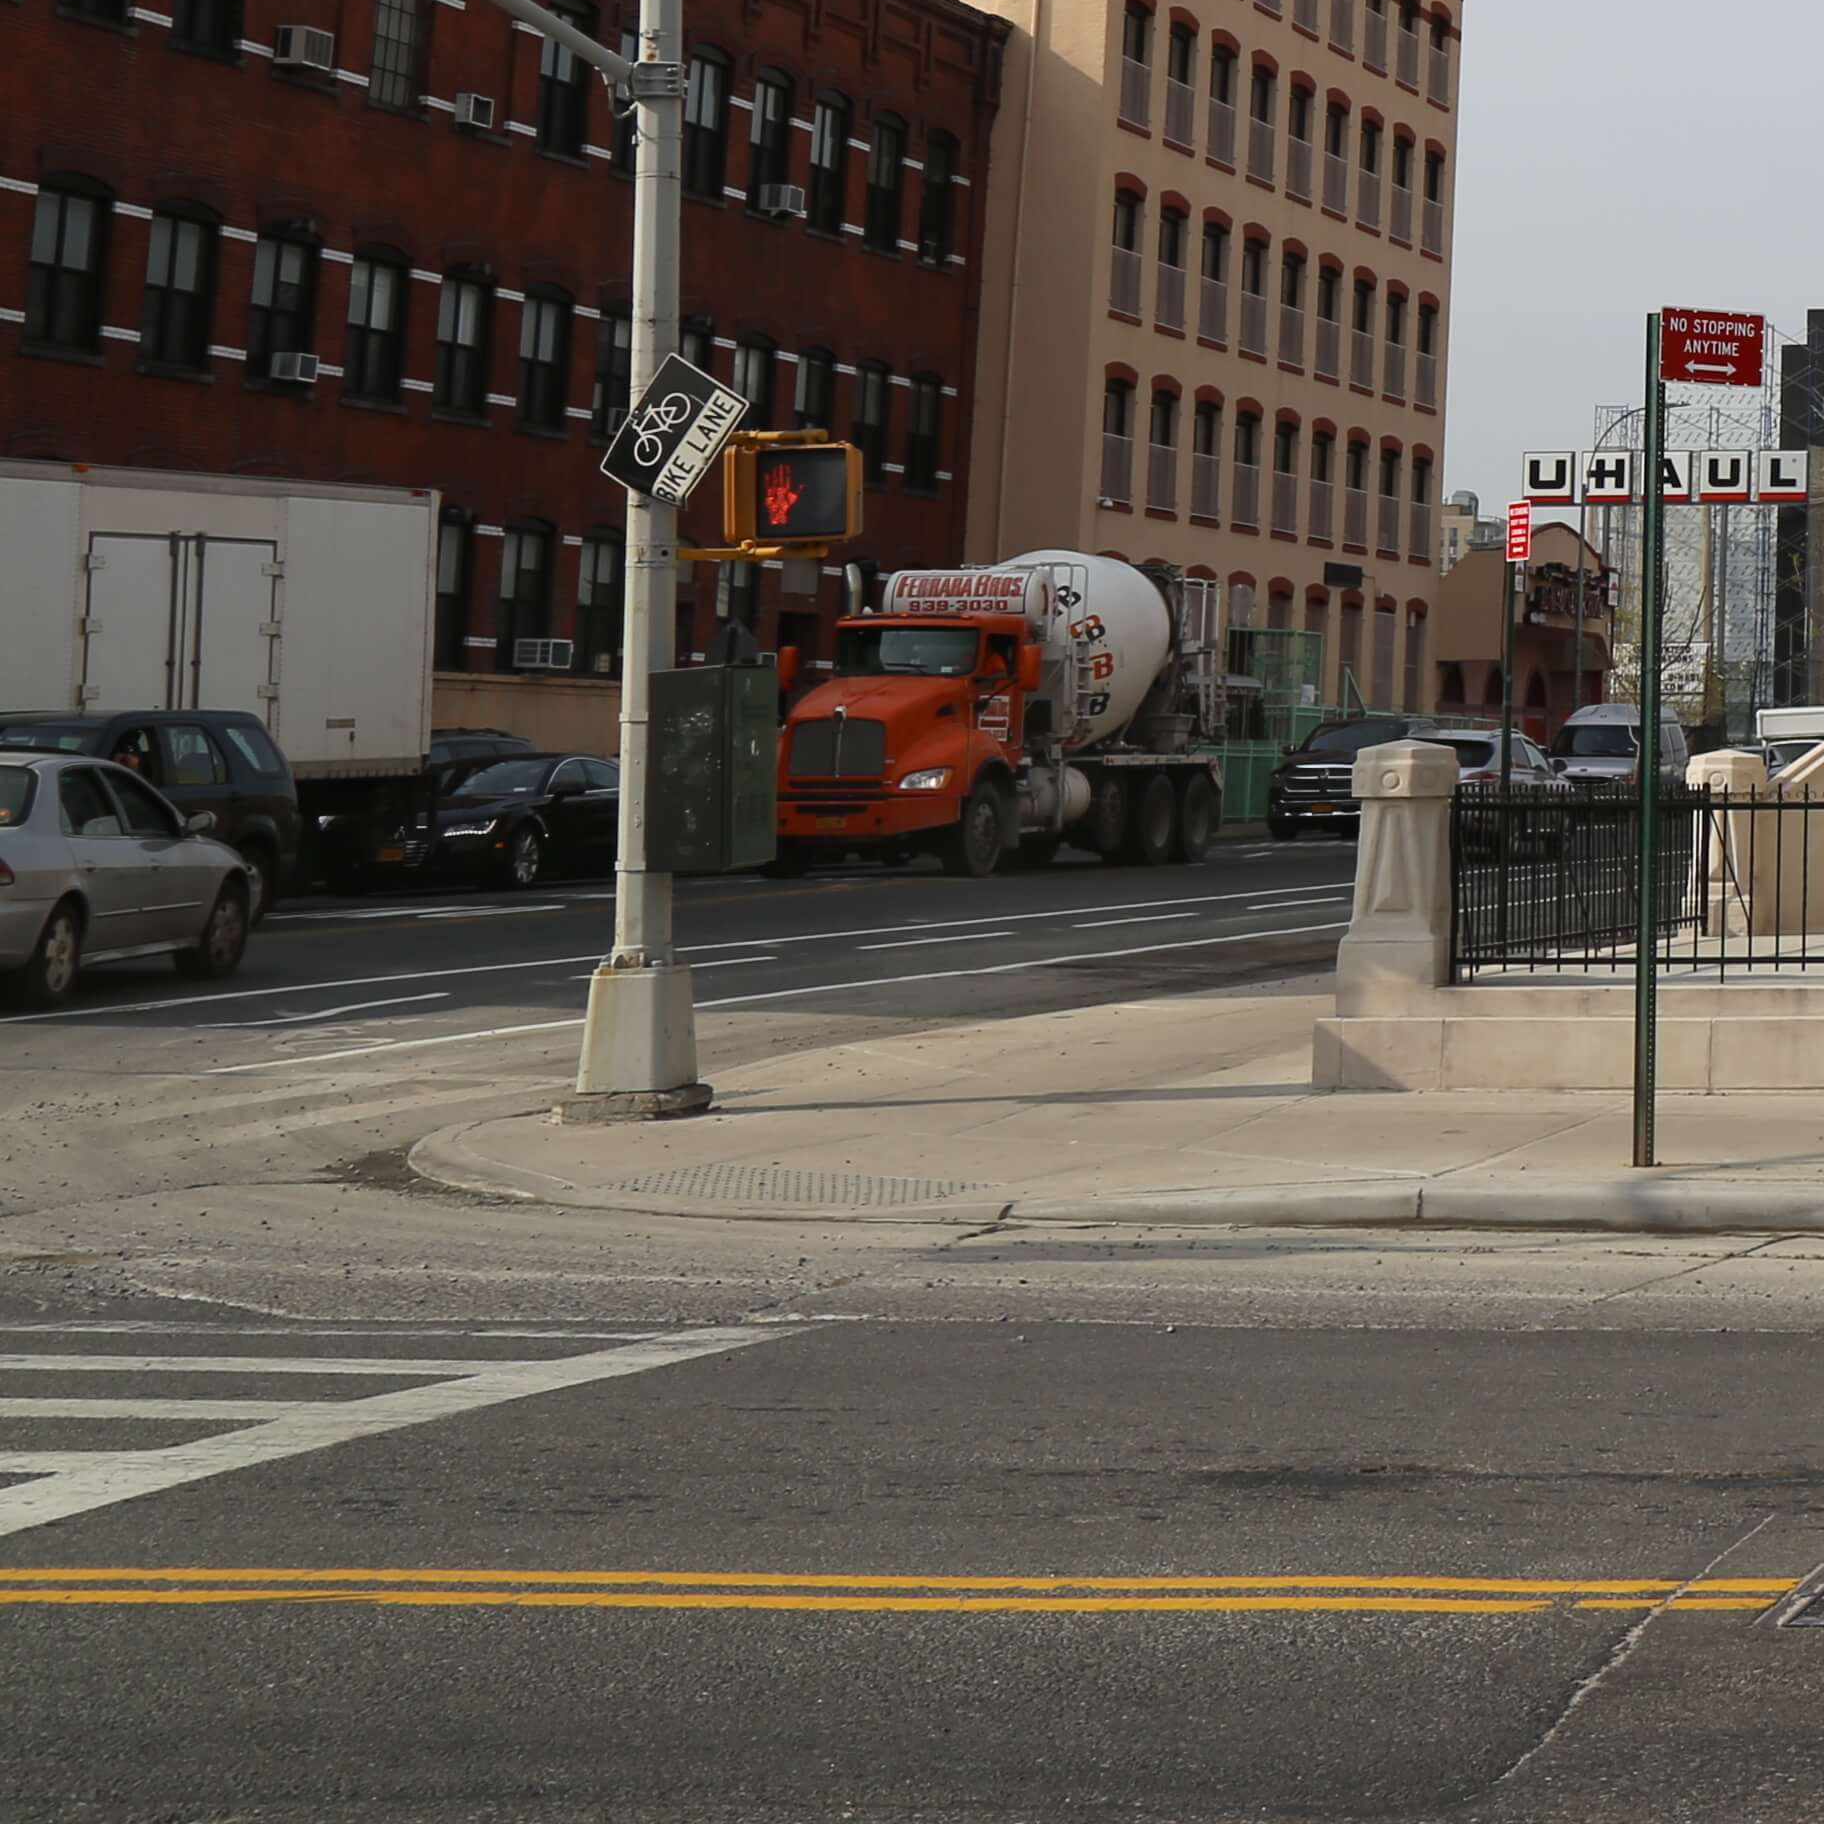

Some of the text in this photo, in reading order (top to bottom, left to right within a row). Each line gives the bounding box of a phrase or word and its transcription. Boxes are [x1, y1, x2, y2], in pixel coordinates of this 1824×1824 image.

[1669, 317, 1756, 338] NO STOPPING
[1683, 338, 1741, 357] ANYTIME
[655, 395, 735, 503] BIKE LANE
[896, 575, 972, 598] FERRARA
[909, 600, 1009, 613] 939-3030
